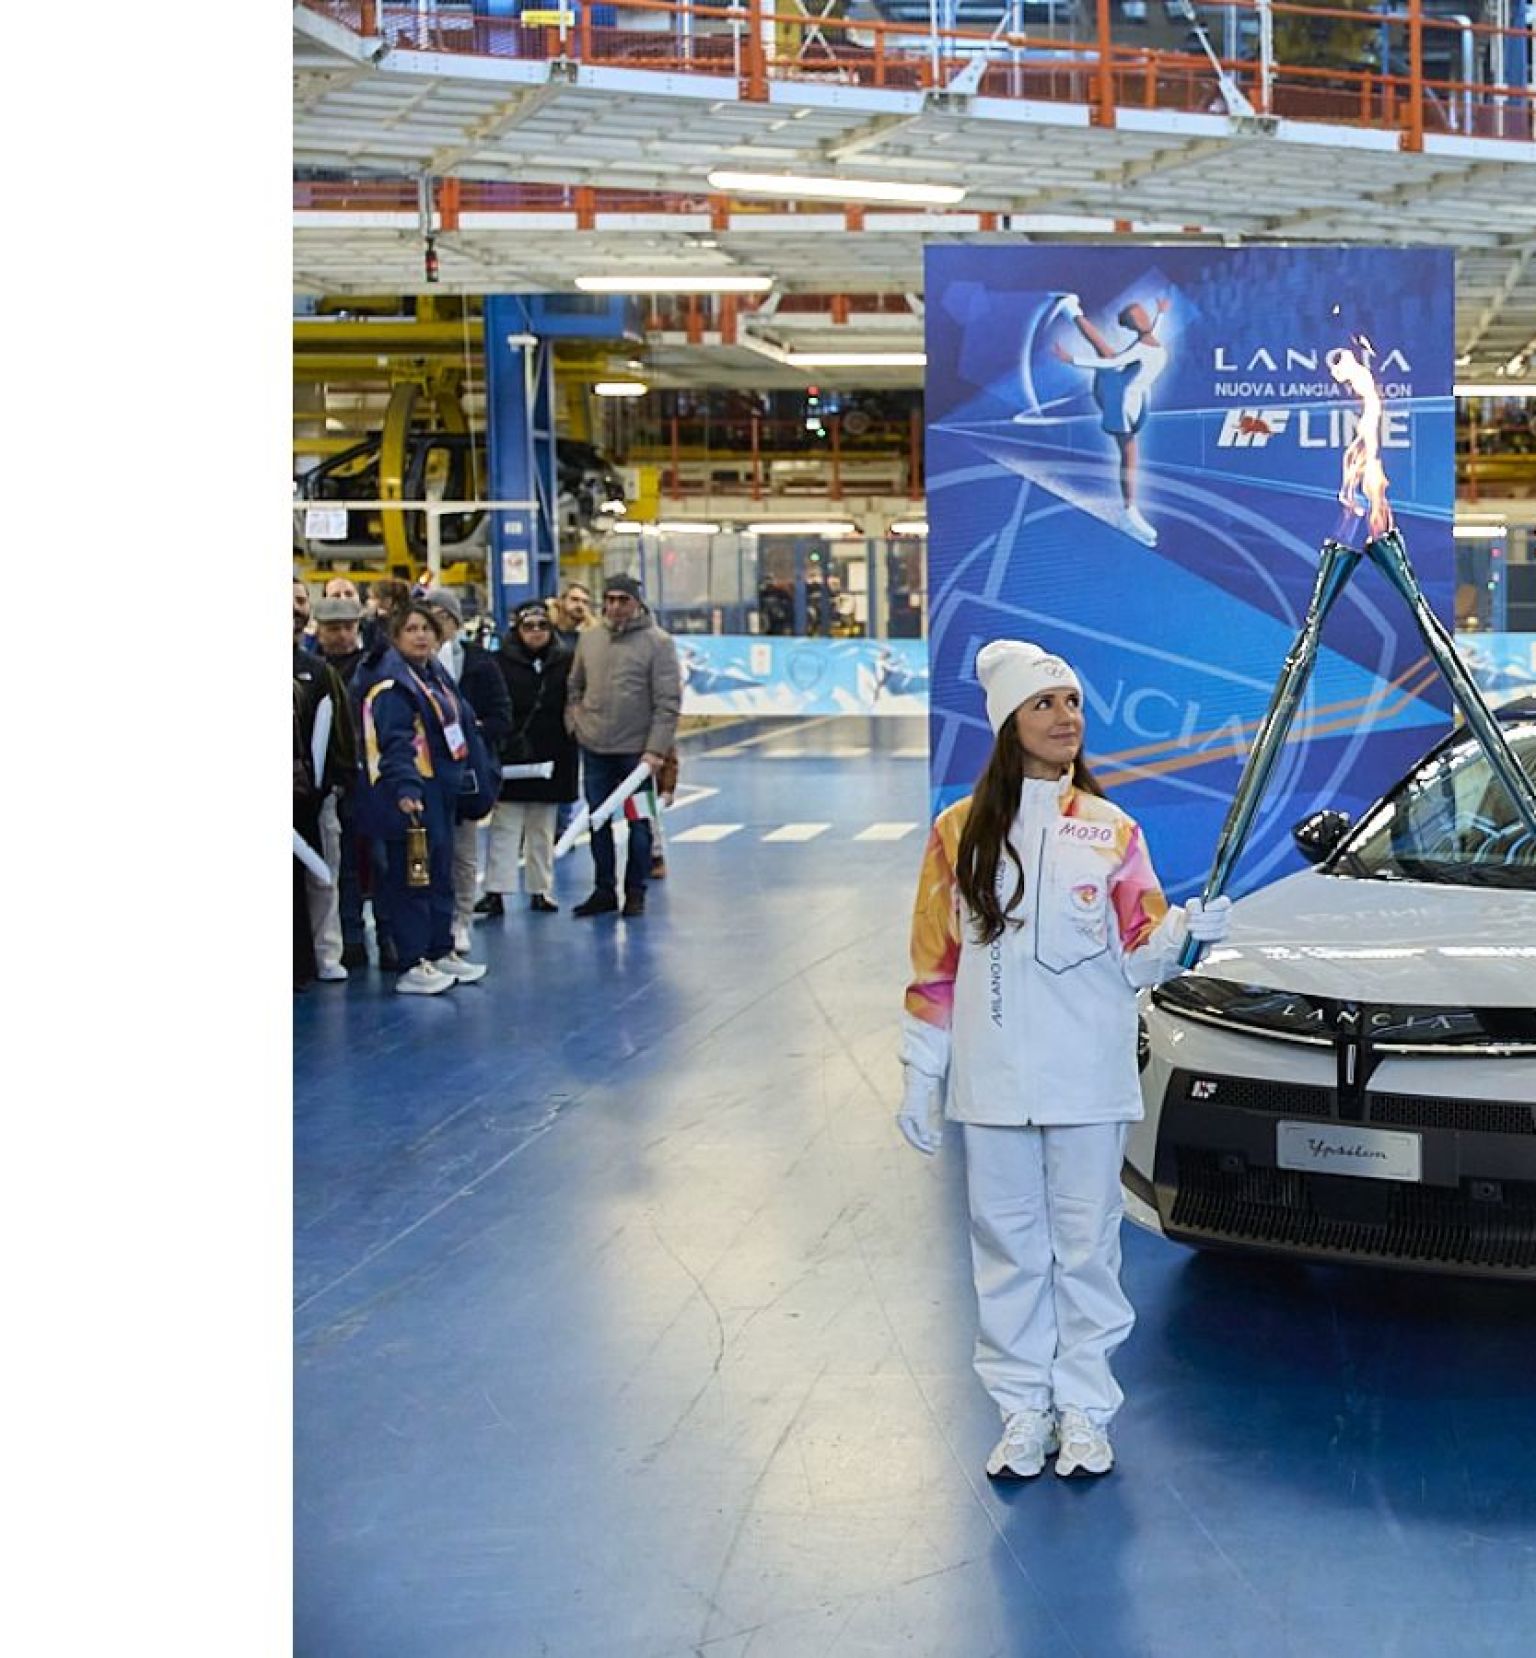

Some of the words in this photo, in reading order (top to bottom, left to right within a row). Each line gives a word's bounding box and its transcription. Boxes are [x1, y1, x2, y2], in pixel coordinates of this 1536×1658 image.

[1215, 382, 1274, 397] NUOVA
[1280, 382, 1340, 397] LANCIA
[1346, 382, 1412, 397] YLON
[990, 963, 1003, 1028] MILANO
[1283, 1003, 1451, 1029] LANCIA
[1307, 1138, 1388, 1160] Ypsilon
